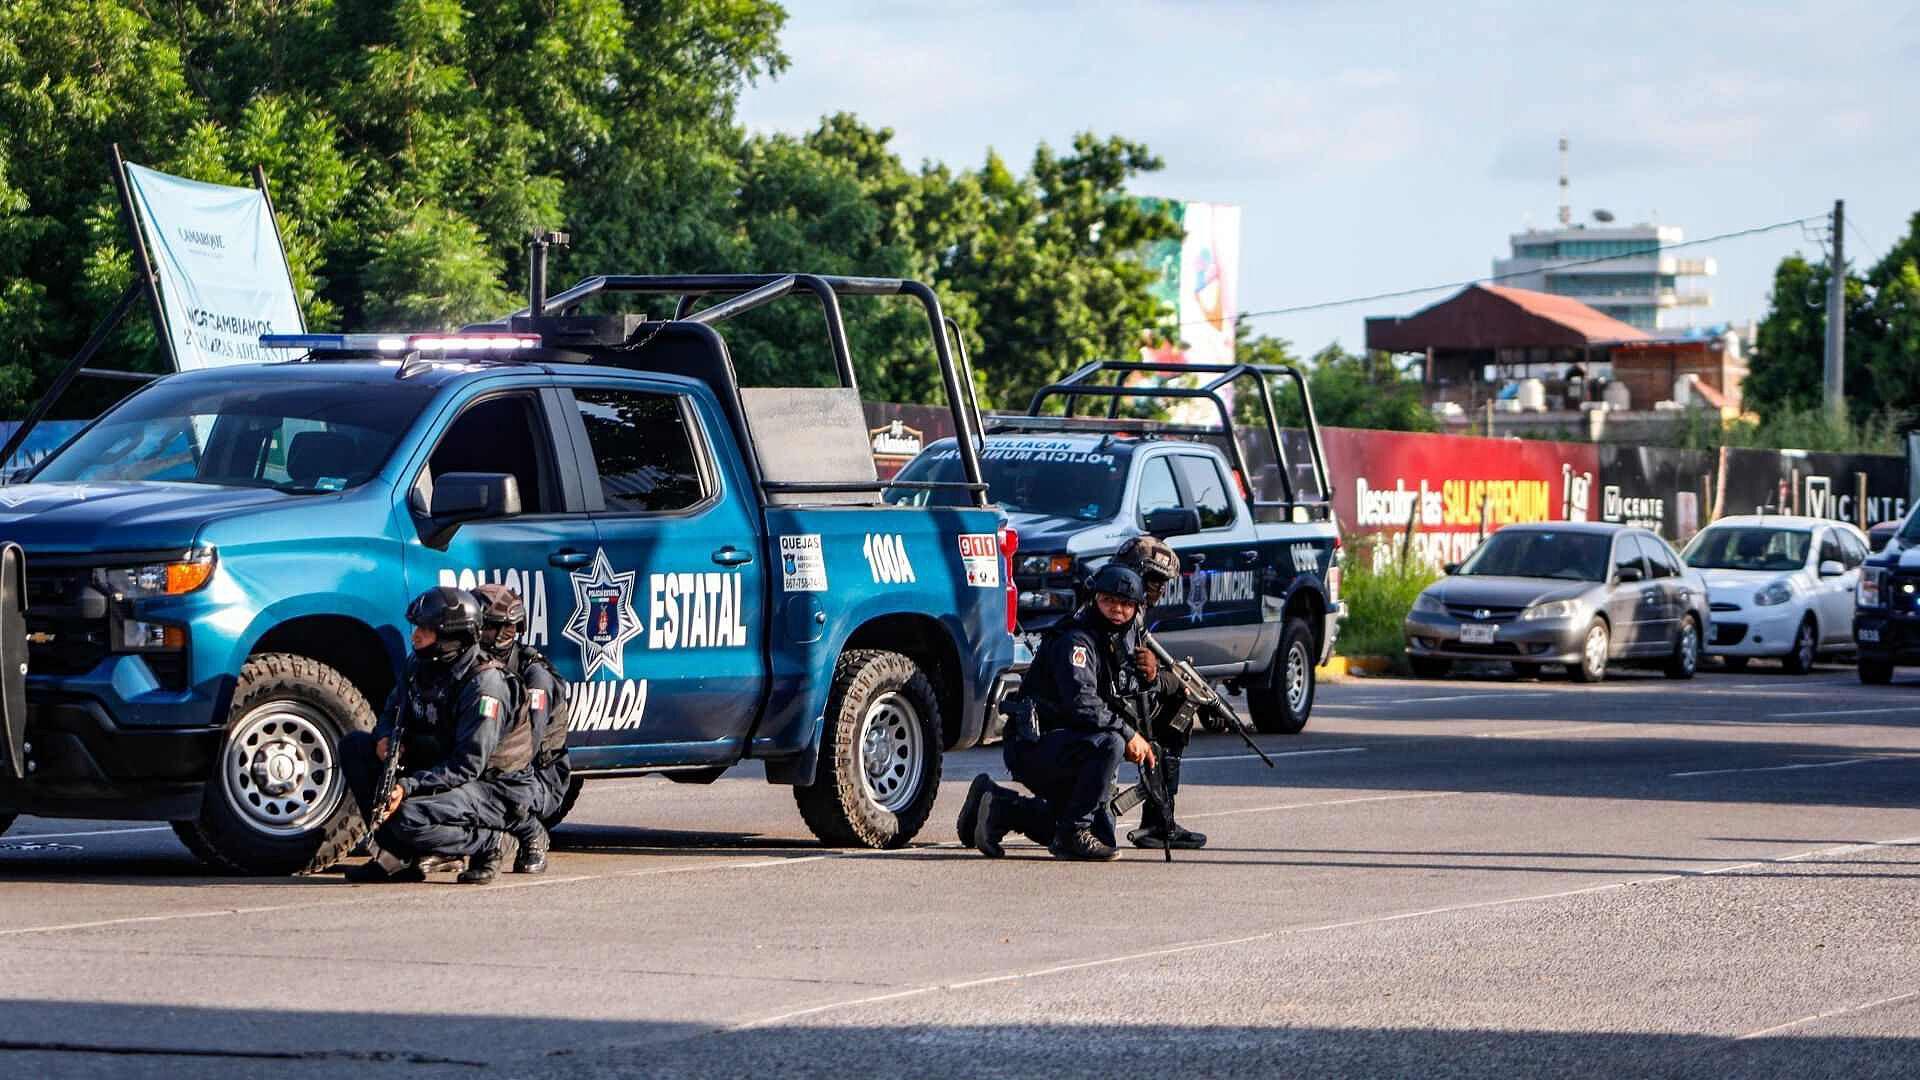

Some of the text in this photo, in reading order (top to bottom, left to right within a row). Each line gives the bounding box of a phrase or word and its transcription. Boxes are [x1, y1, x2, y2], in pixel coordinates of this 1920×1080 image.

[1603, 486, 1664, 521] VICENTE
[782, 537, 819, 550] QUEJAS
[863, 533, 916, 584] 100A
[961, 537, 995, 556] 911
[649, 572, 747, 650] ESTATAL
